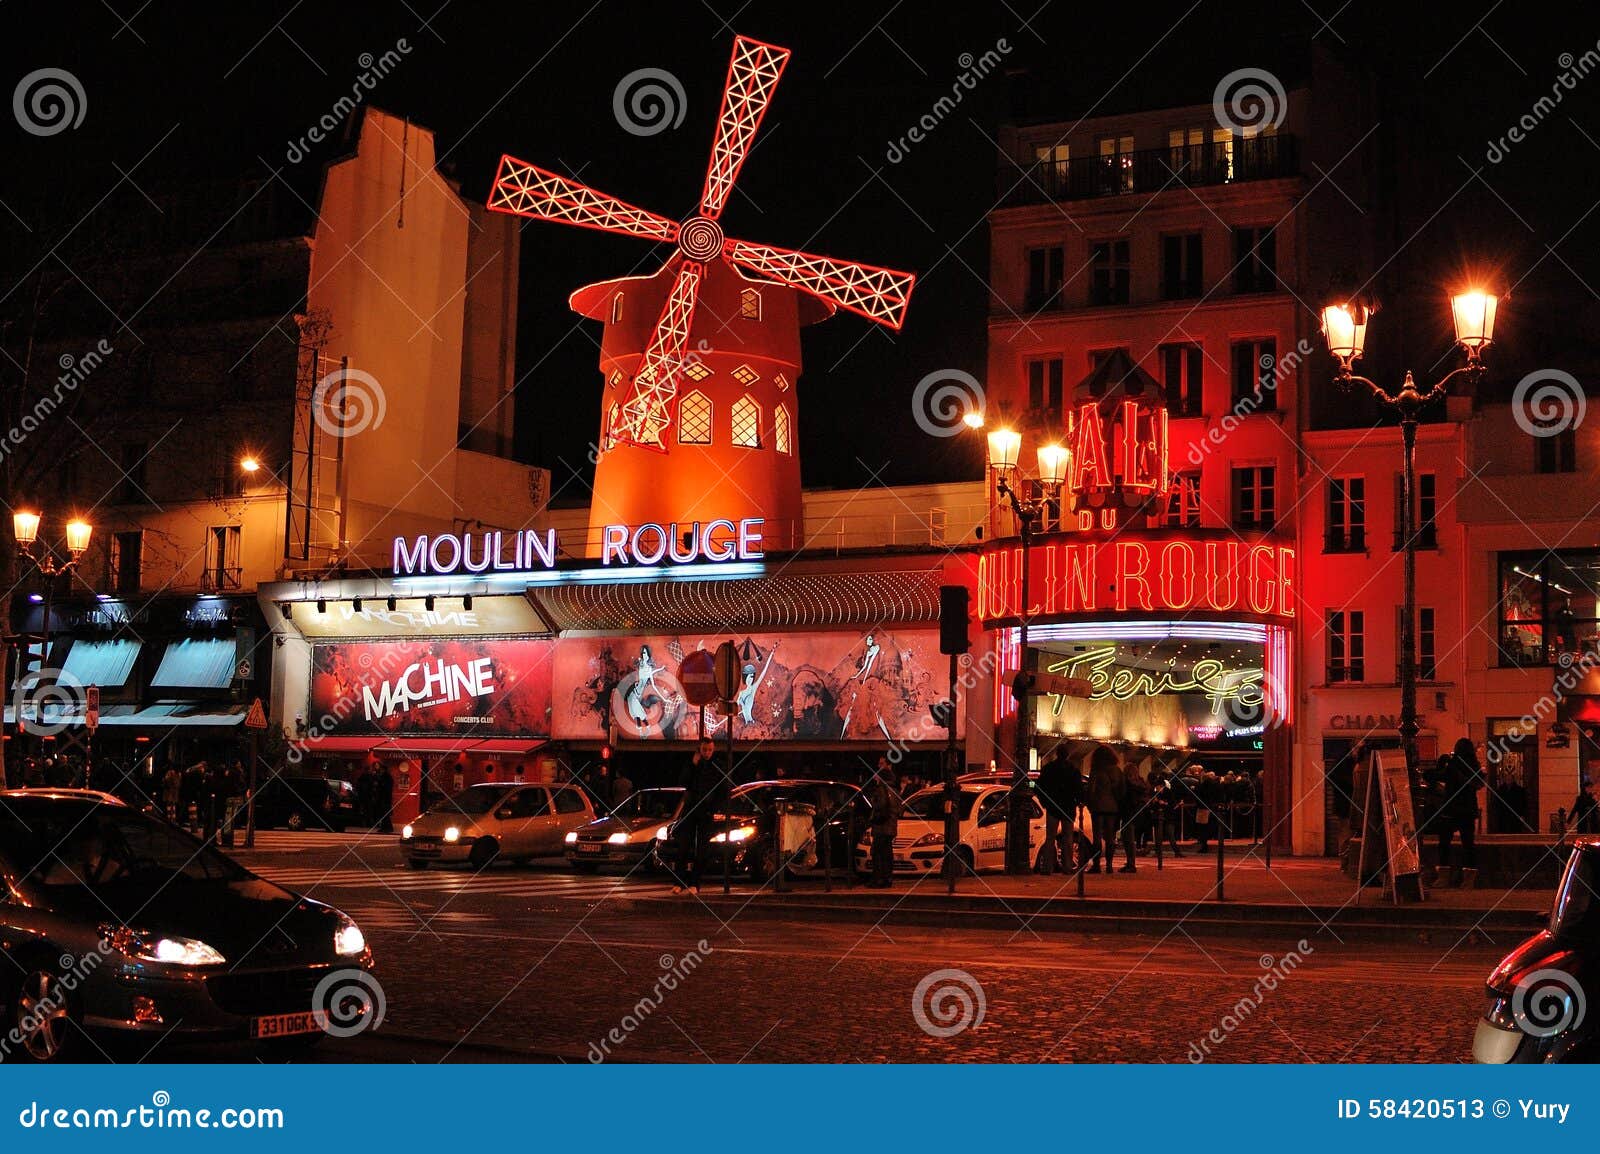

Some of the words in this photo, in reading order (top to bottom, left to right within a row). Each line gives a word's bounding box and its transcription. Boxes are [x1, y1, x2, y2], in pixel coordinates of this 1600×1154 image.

[1079, 509, 1116, 531] DU
[392, 528, 556, 574] MOULIN
[601, 518, 765, 565] ROUGE
[978, 544, 1096, 620] OULIN
[1116, 542, 1295, 617] ROUGE
[362, 657, 494, 721] MACHINE
[453, 716, 479, 724] CONCERTS
[480, 717, 494, 725] CLUB
[1330, 714, 1426, 729] CHANE
